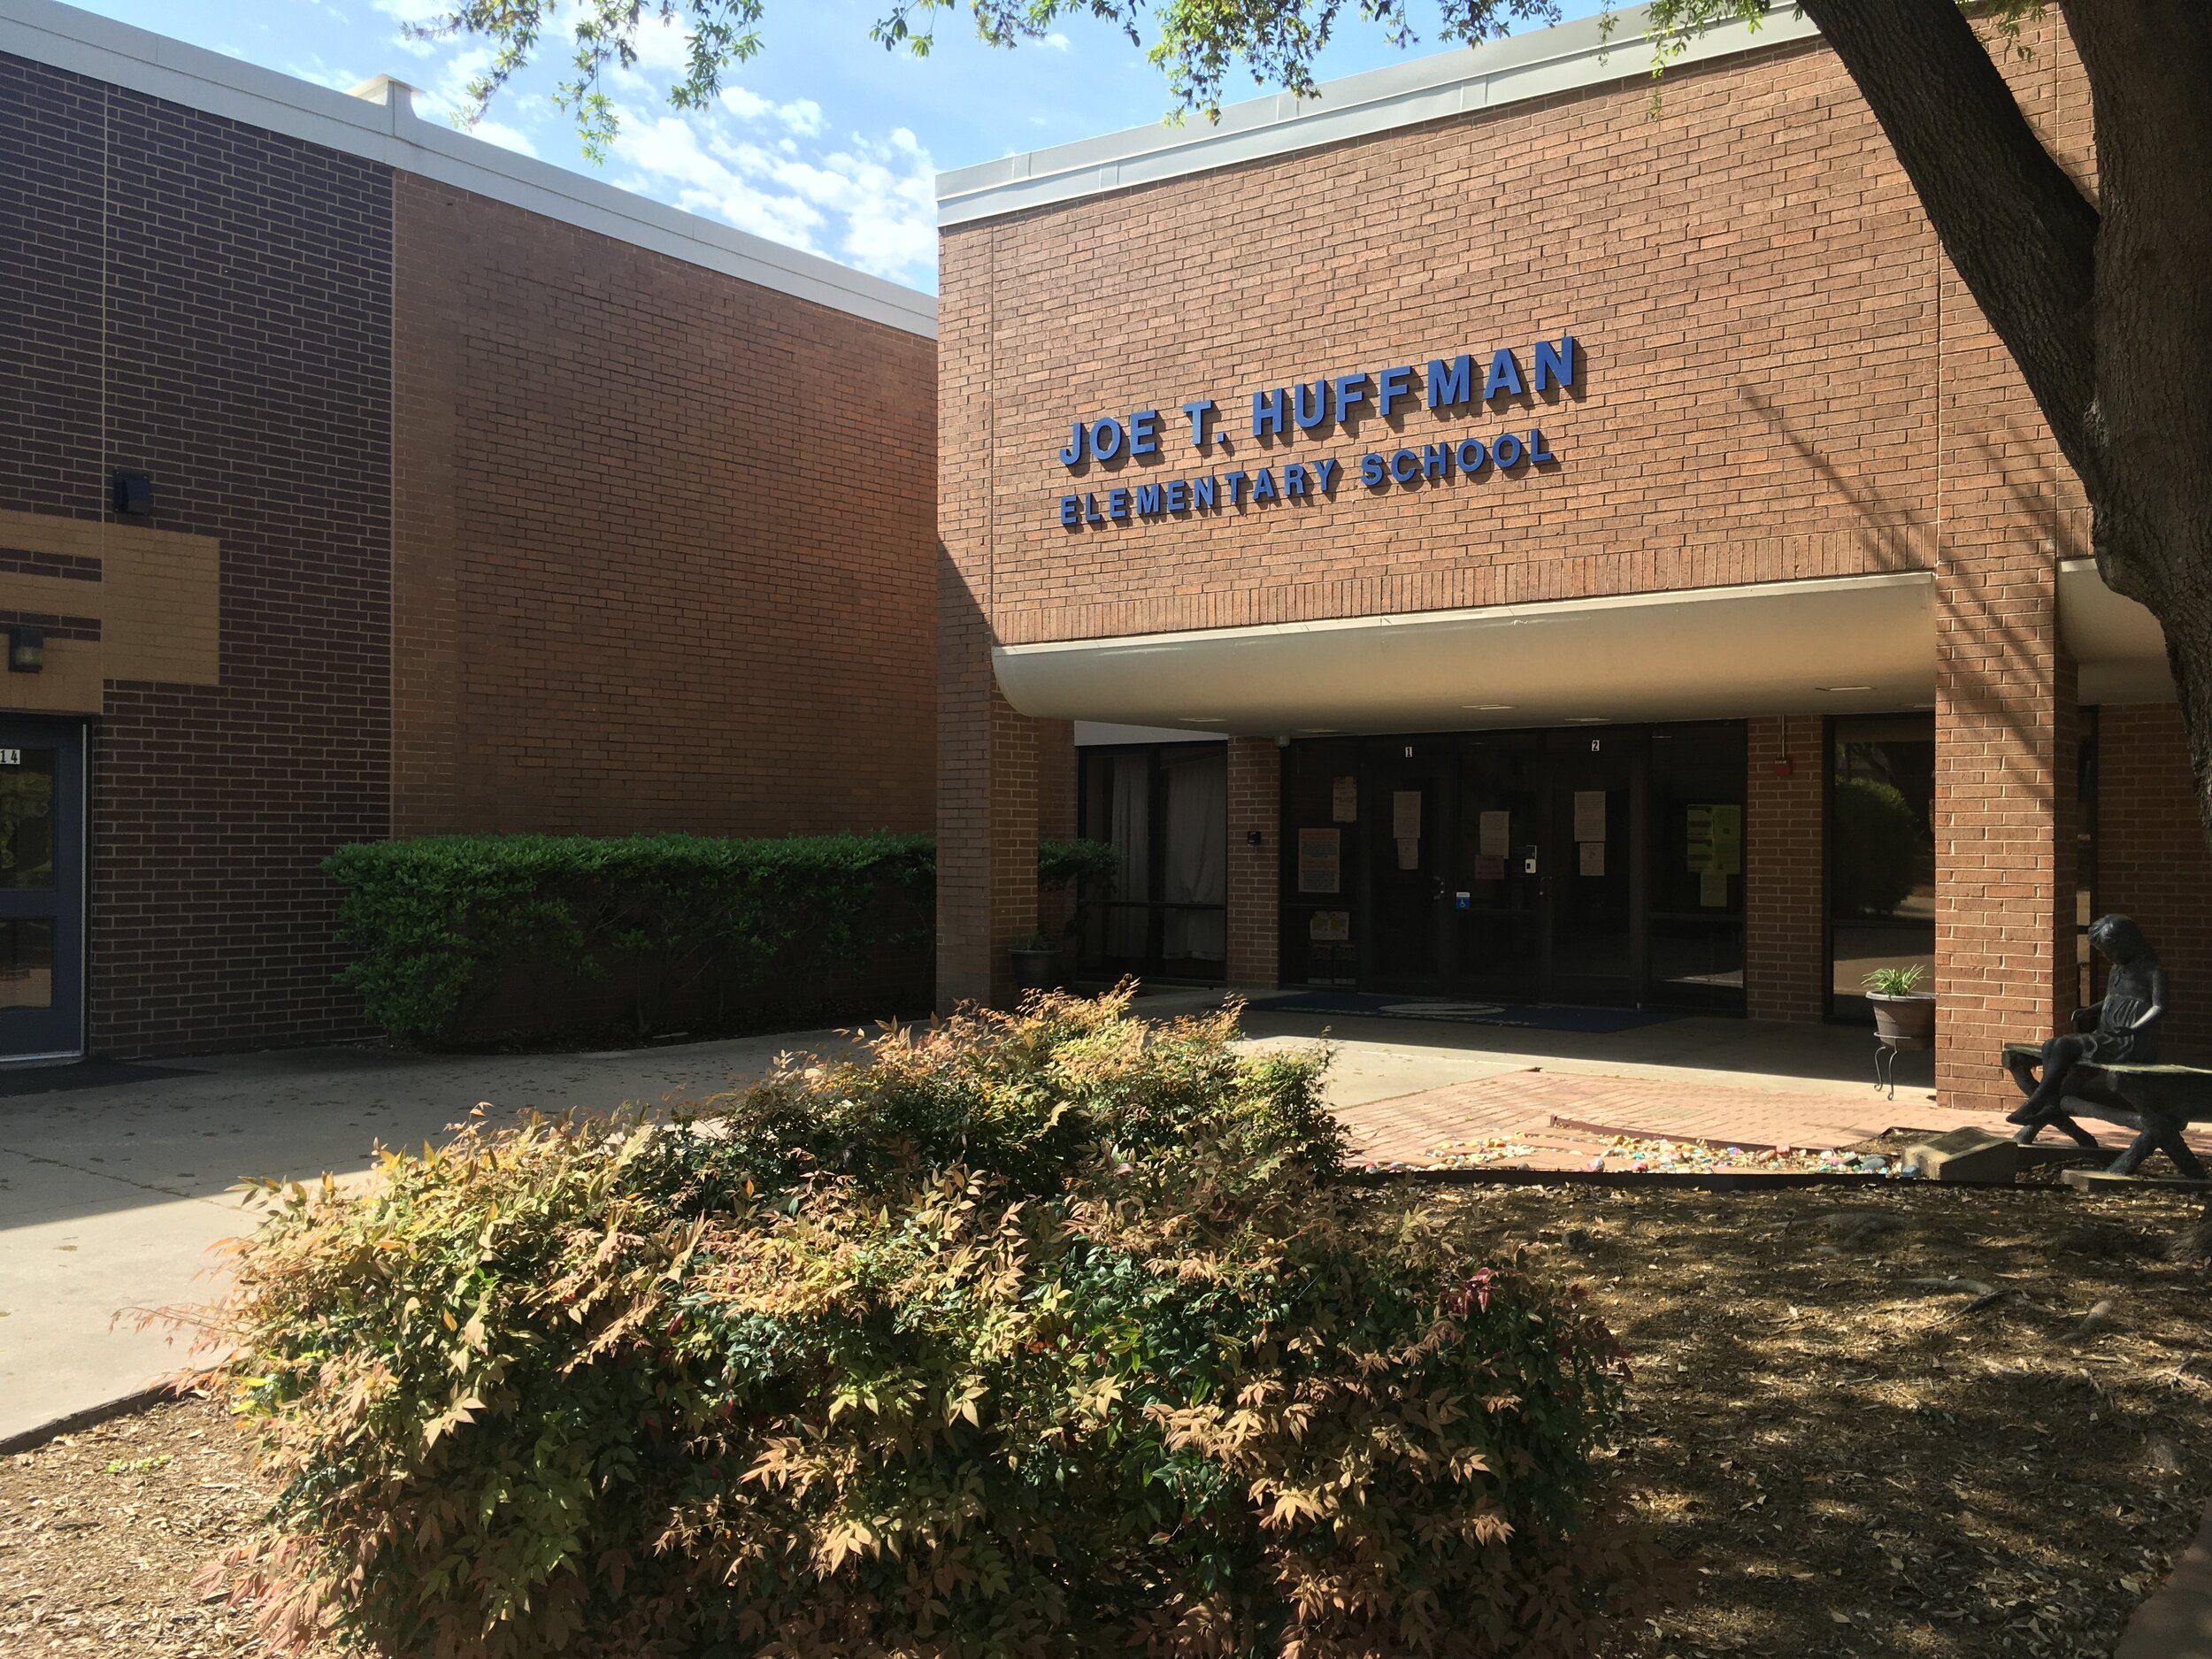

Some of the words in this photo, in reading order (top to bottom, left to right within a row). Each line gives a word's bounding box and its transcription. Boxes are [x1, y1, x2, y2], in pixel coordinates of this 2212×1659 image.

[1058, 410, 1157, 466] JOE
[1182, 400, 1226, 446] T.
[1252, 335, 1574, 437] HUFFMAN
[1060, 458, 1336, 526] ELEMENTARY
[1360, 428, 1554, 487] SCHOOL
[0, 749, 18, 764] 14
[1593, 741, 1599, 751] 2
